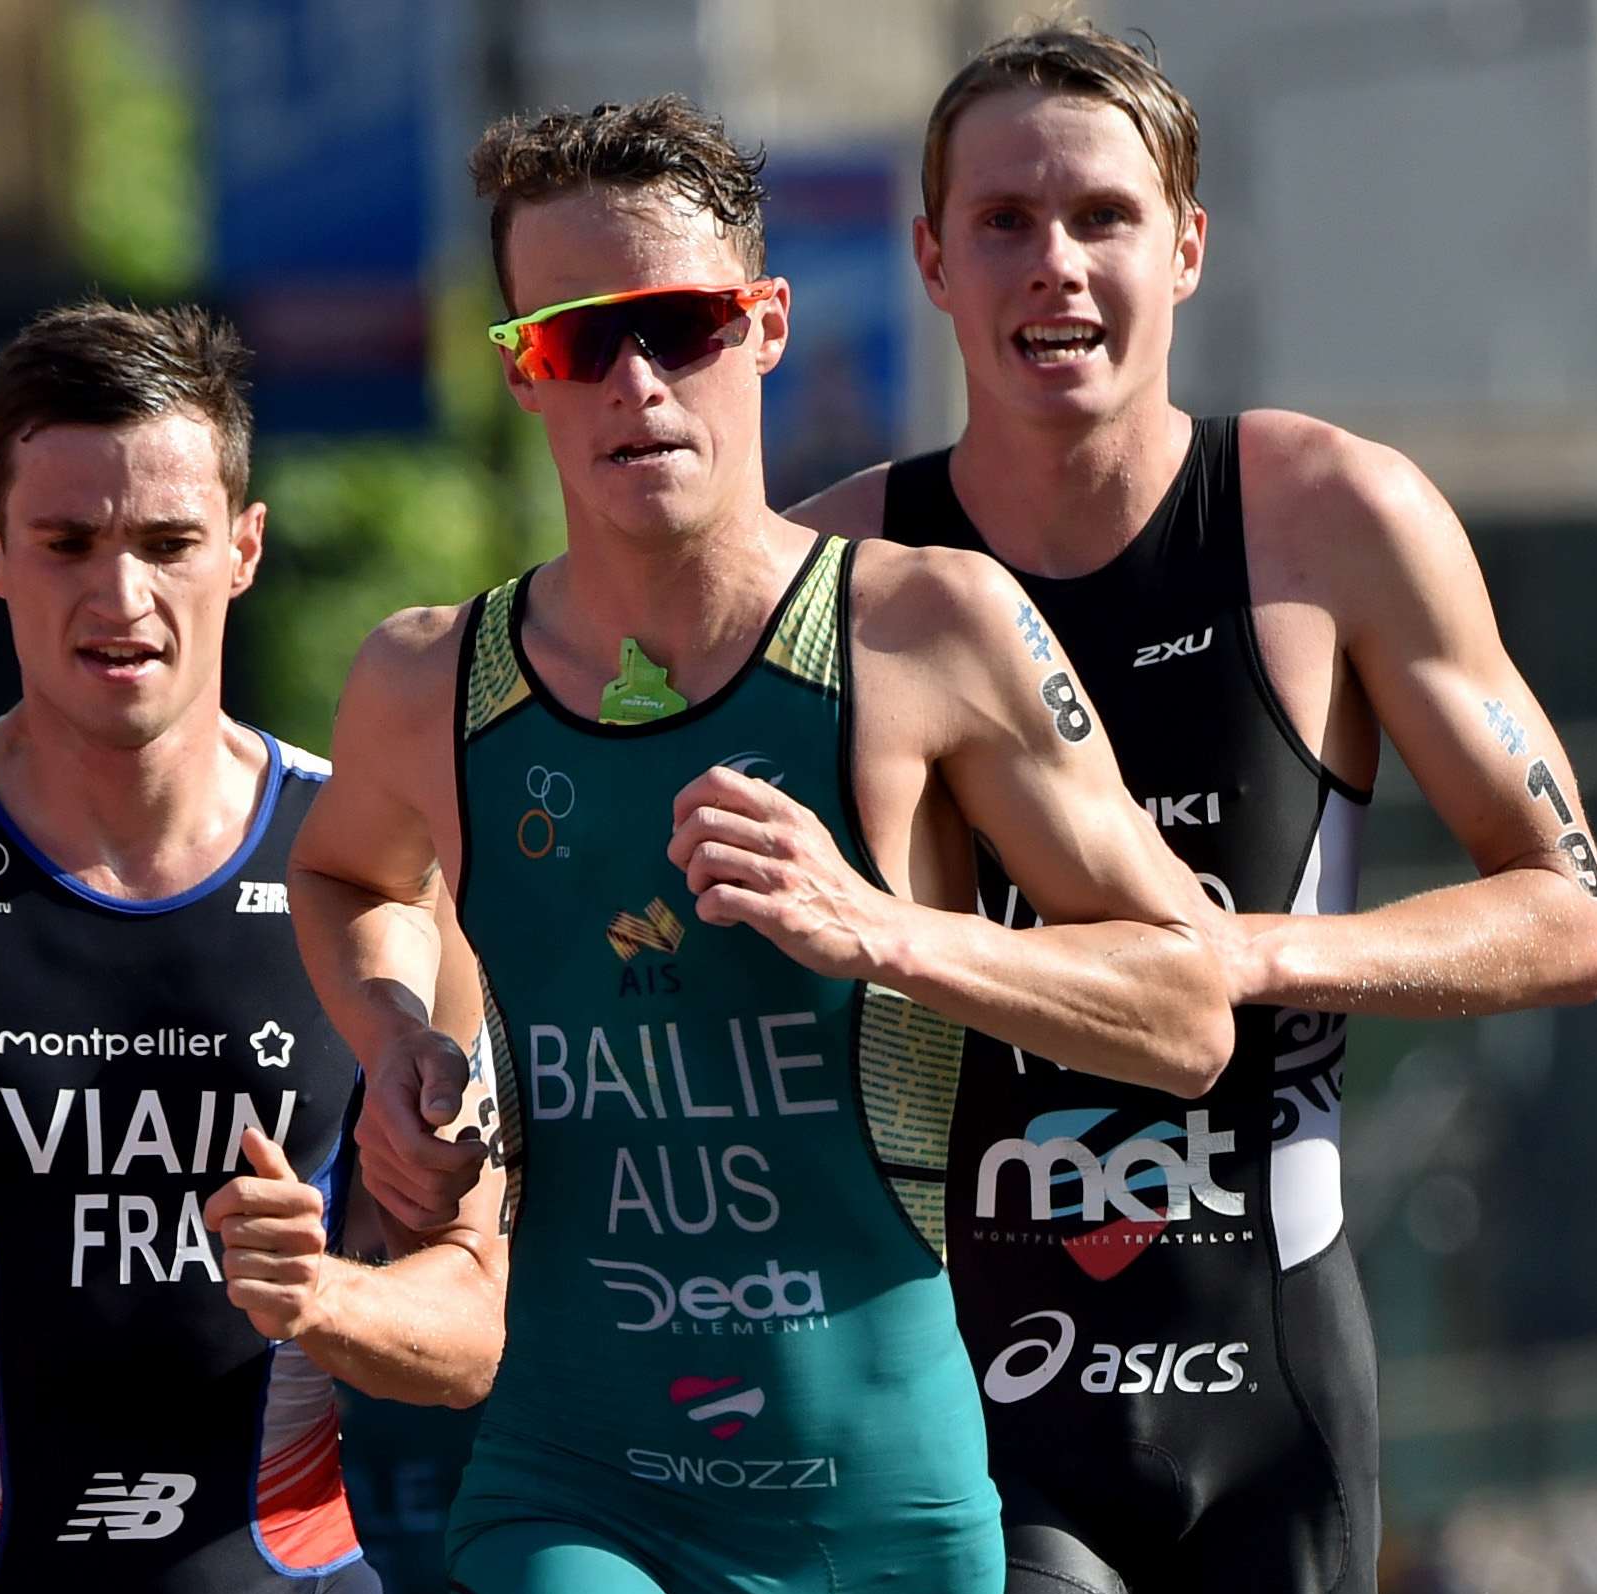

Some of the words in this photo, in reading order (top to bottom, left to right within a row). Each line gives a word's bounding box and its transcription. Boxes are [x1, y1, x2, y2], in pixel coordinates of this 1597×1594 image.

[1132, 627, 1214, 667] 2XU
[1037, 671, 1093, 746] 8
[618, 963, 682, 998] AIS
[529, 1012, 839, 1122] BAILIE
[0, 1087, 298, 1176] VIAIN
[607, 1144, 781, 1236] AUS
[70, 1191, 224, 1288] FRA
[972, 1230, 1110, 1247] MONTPELLIER
[1122, 1229, 1254, 1246] TRIATHLON
[586, 1257, 826, 1333] Deda
[671, 1314, 831, 1336] ELEMENTI
[626, 1448, 838, 1490] SWOZZI
[56, 1471, 198, 1542] NB
